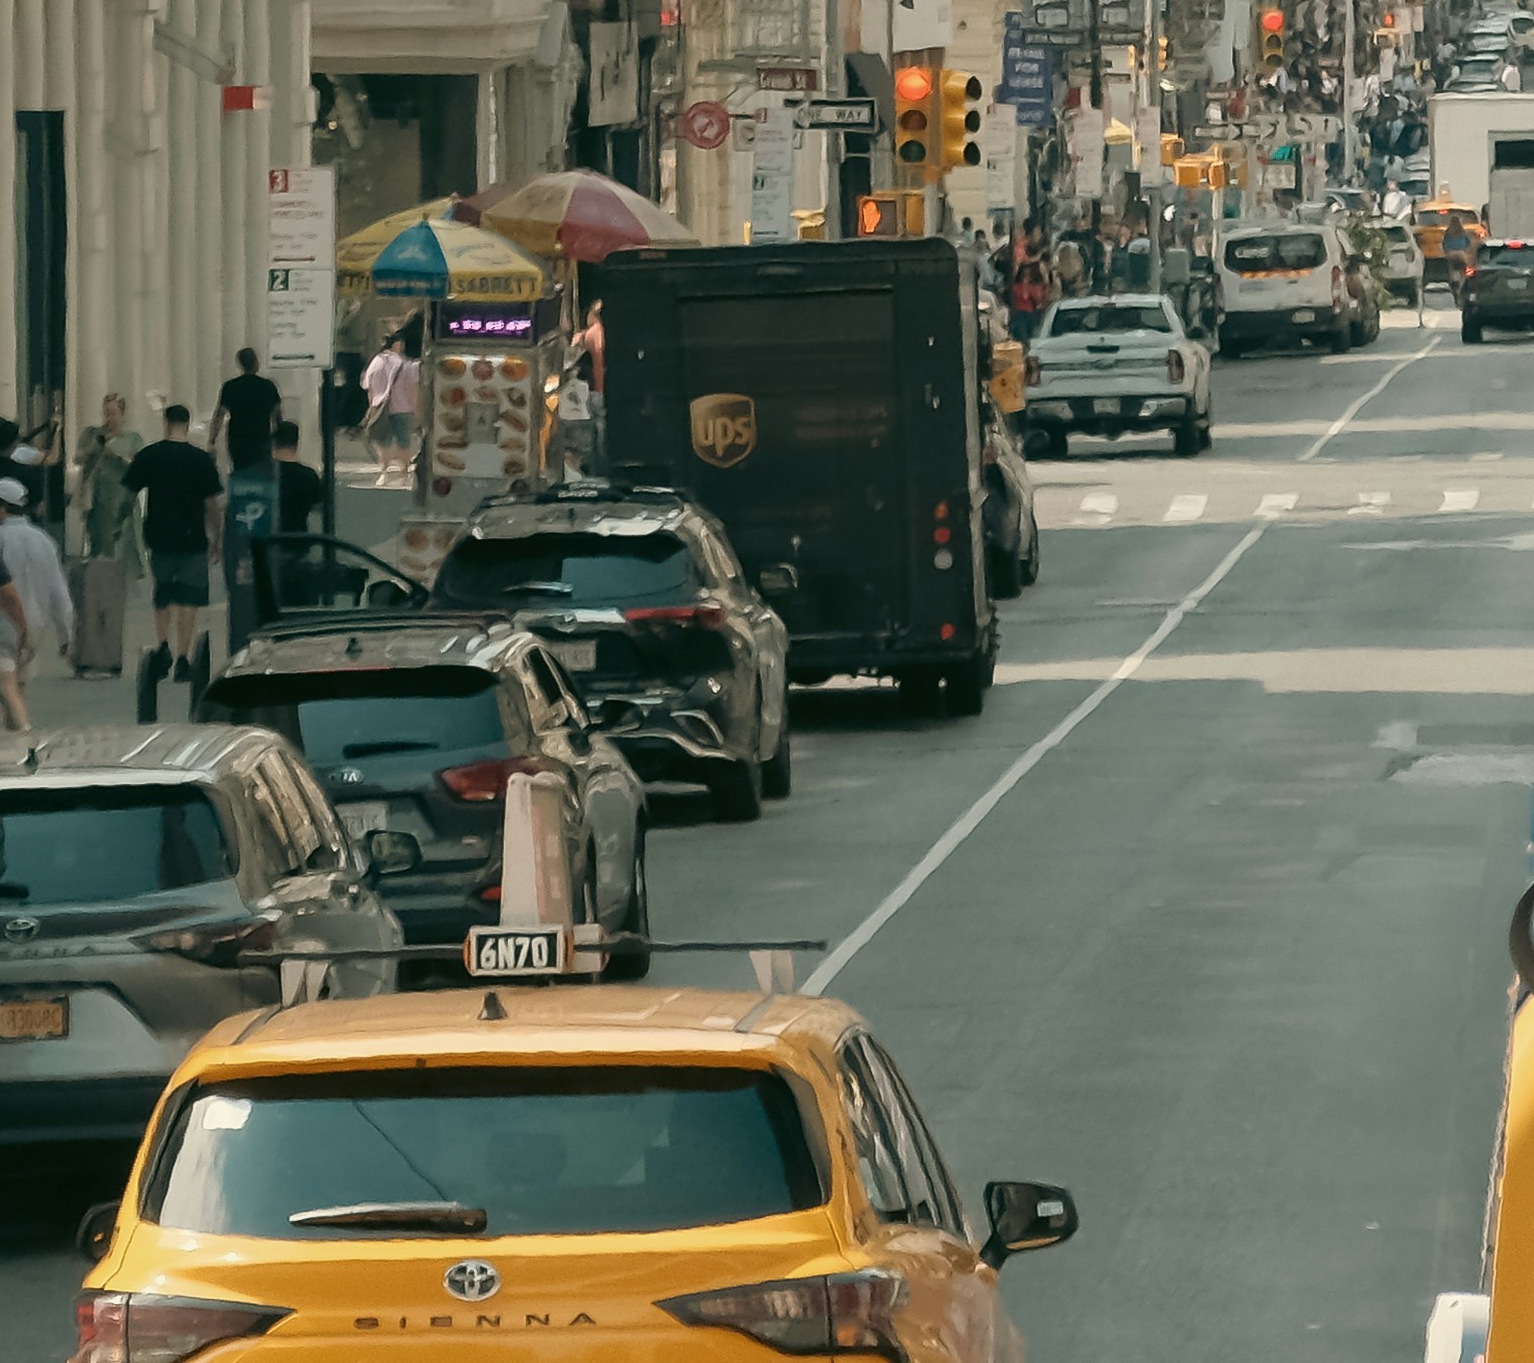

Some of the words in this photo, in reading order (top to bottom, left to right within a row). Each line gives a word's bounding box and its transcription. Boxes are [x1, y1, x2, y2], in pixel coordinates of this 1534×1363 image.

[835, 106, 863, 121] WAY
[699, 416, 753, 458] ups
[479, 935, 550, 972] 6N70
[353, 1312, 597, 1330] SIENNA
